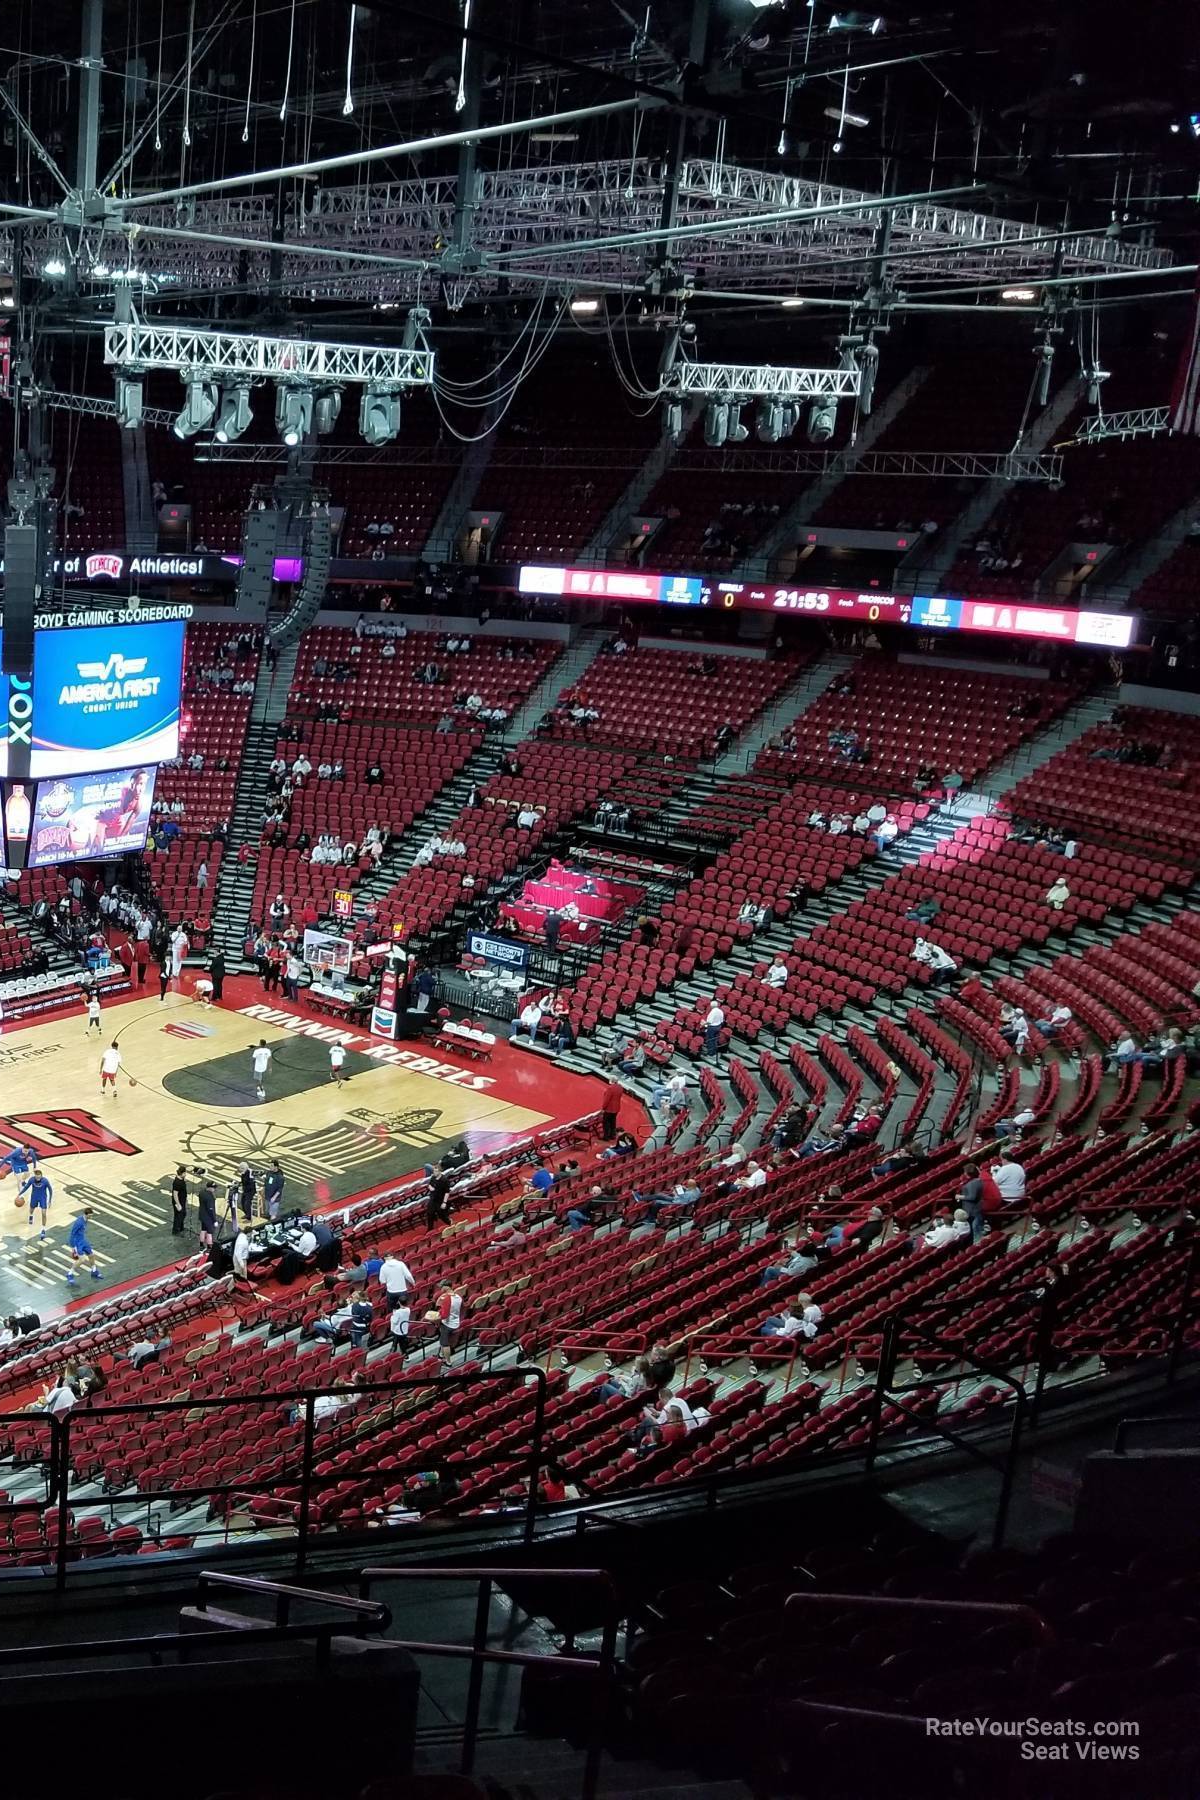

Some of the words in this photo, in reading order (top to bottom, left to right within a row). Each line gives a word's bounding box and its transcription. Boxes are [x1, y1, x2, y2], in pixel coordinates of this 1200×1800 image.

[64, 557, 79, 572] of
[130, 558, 203, 575] Athletics!
[724, 593, 734, 607] 0
[773, 590, 829, 611] 21:53
[858, 595, 895, 605] BRONCOS
[68, 610, 113, 626] GAMING
[117, 604, 194, 622] SCOREBOARD
[869, 605, 880, 620] 0
[900, 612, 908, 622] 4
[59, 680, 122, 705] AMERICA
[123, 677, 161, 698] FIRST
[83, 703, 112, 714] CREDIT
[115, 700, 139, 711] UNION
[336, 900, 348, 913] 30
[486, 948, 515, 959] NETWORK
[498, 945, 521, 956] SPORTS
[22, 1043, 65, 1058] FIRST
[238, 1003, 372, 1046] RUNNIN'
[360, 1043, 498, 1090] REBELS
